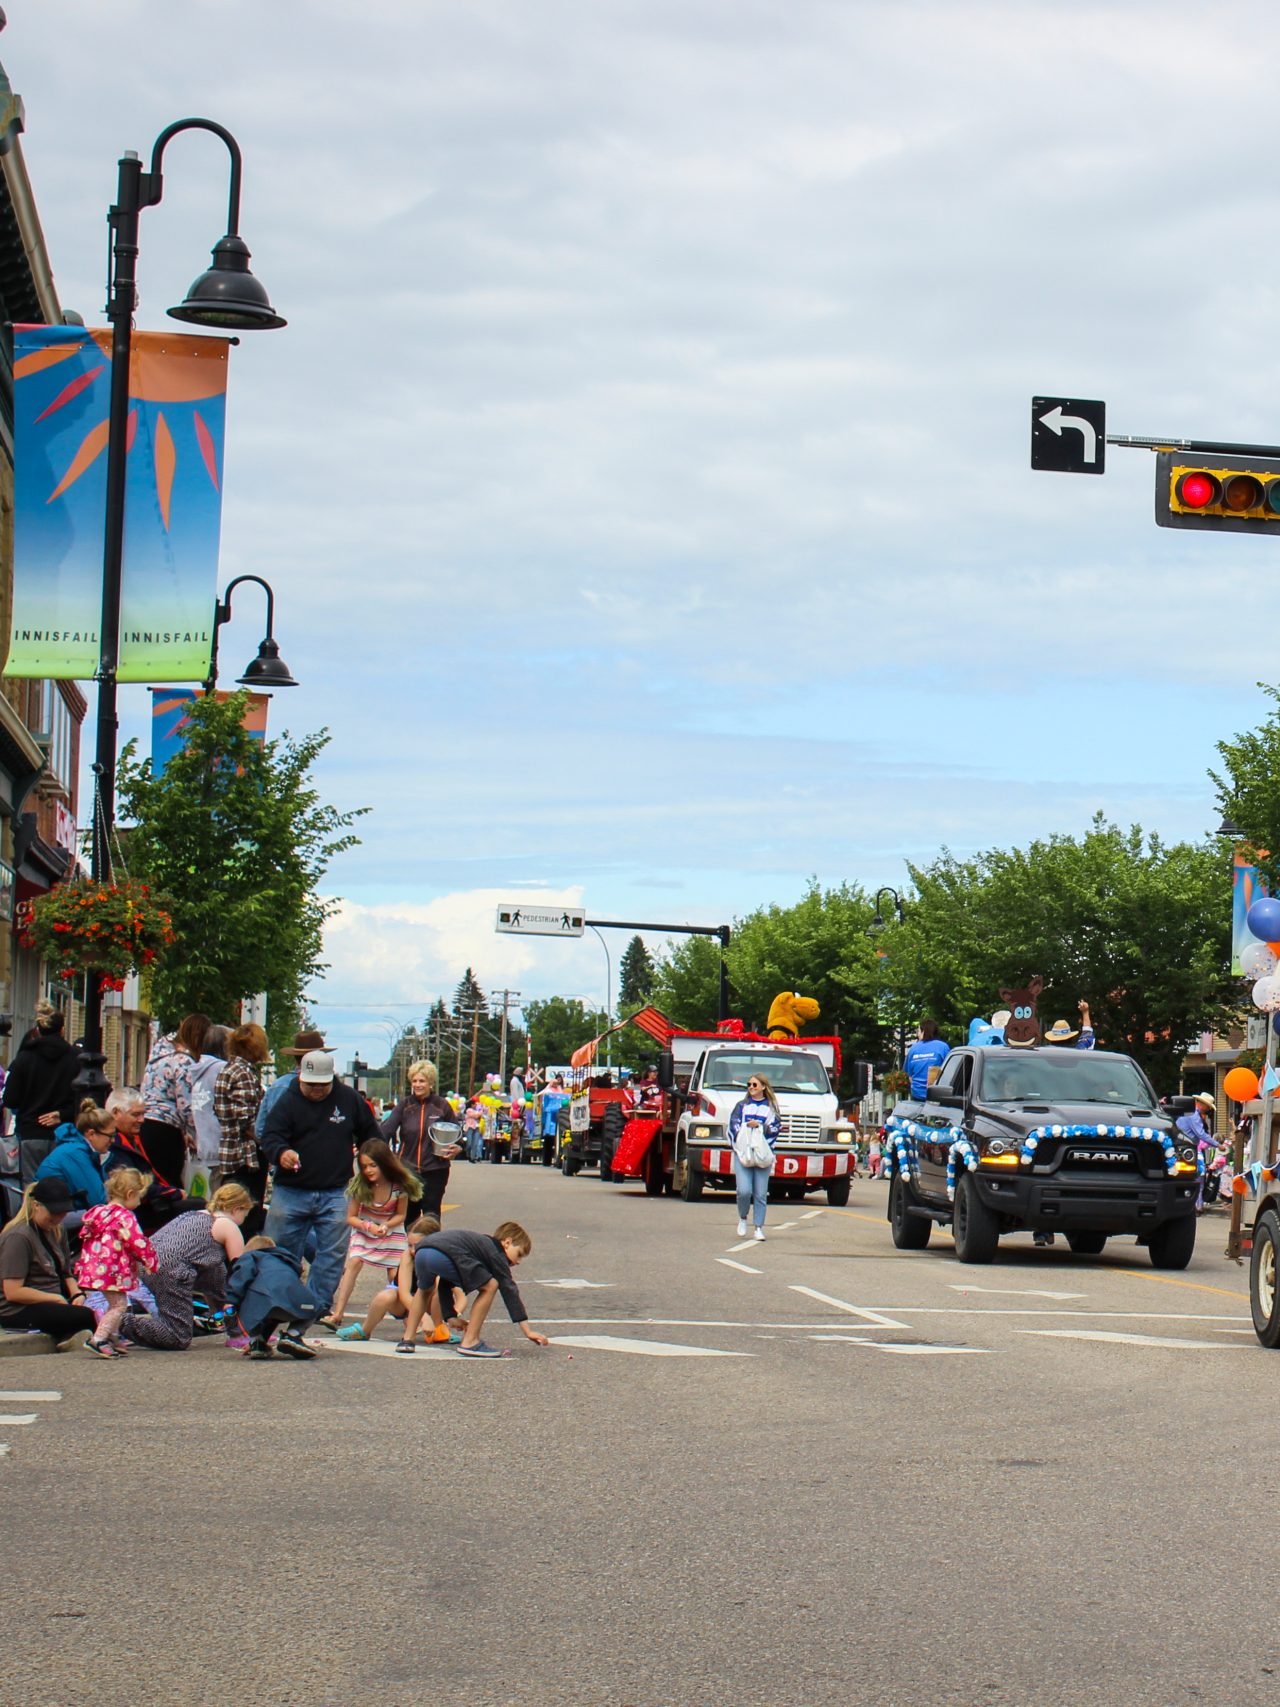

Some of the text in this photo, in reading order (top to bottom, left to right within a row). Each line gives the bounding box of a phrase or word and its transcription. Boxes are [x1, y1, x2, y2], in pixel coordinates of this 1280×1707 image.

[14, 630, 98, 643] INNISFAIL
[124, 632, 209, 643] INNISFAIL
[523, 914, 560, 924] PEDESTRIAN
[1073, 1152, 1129, 1161] RAM
